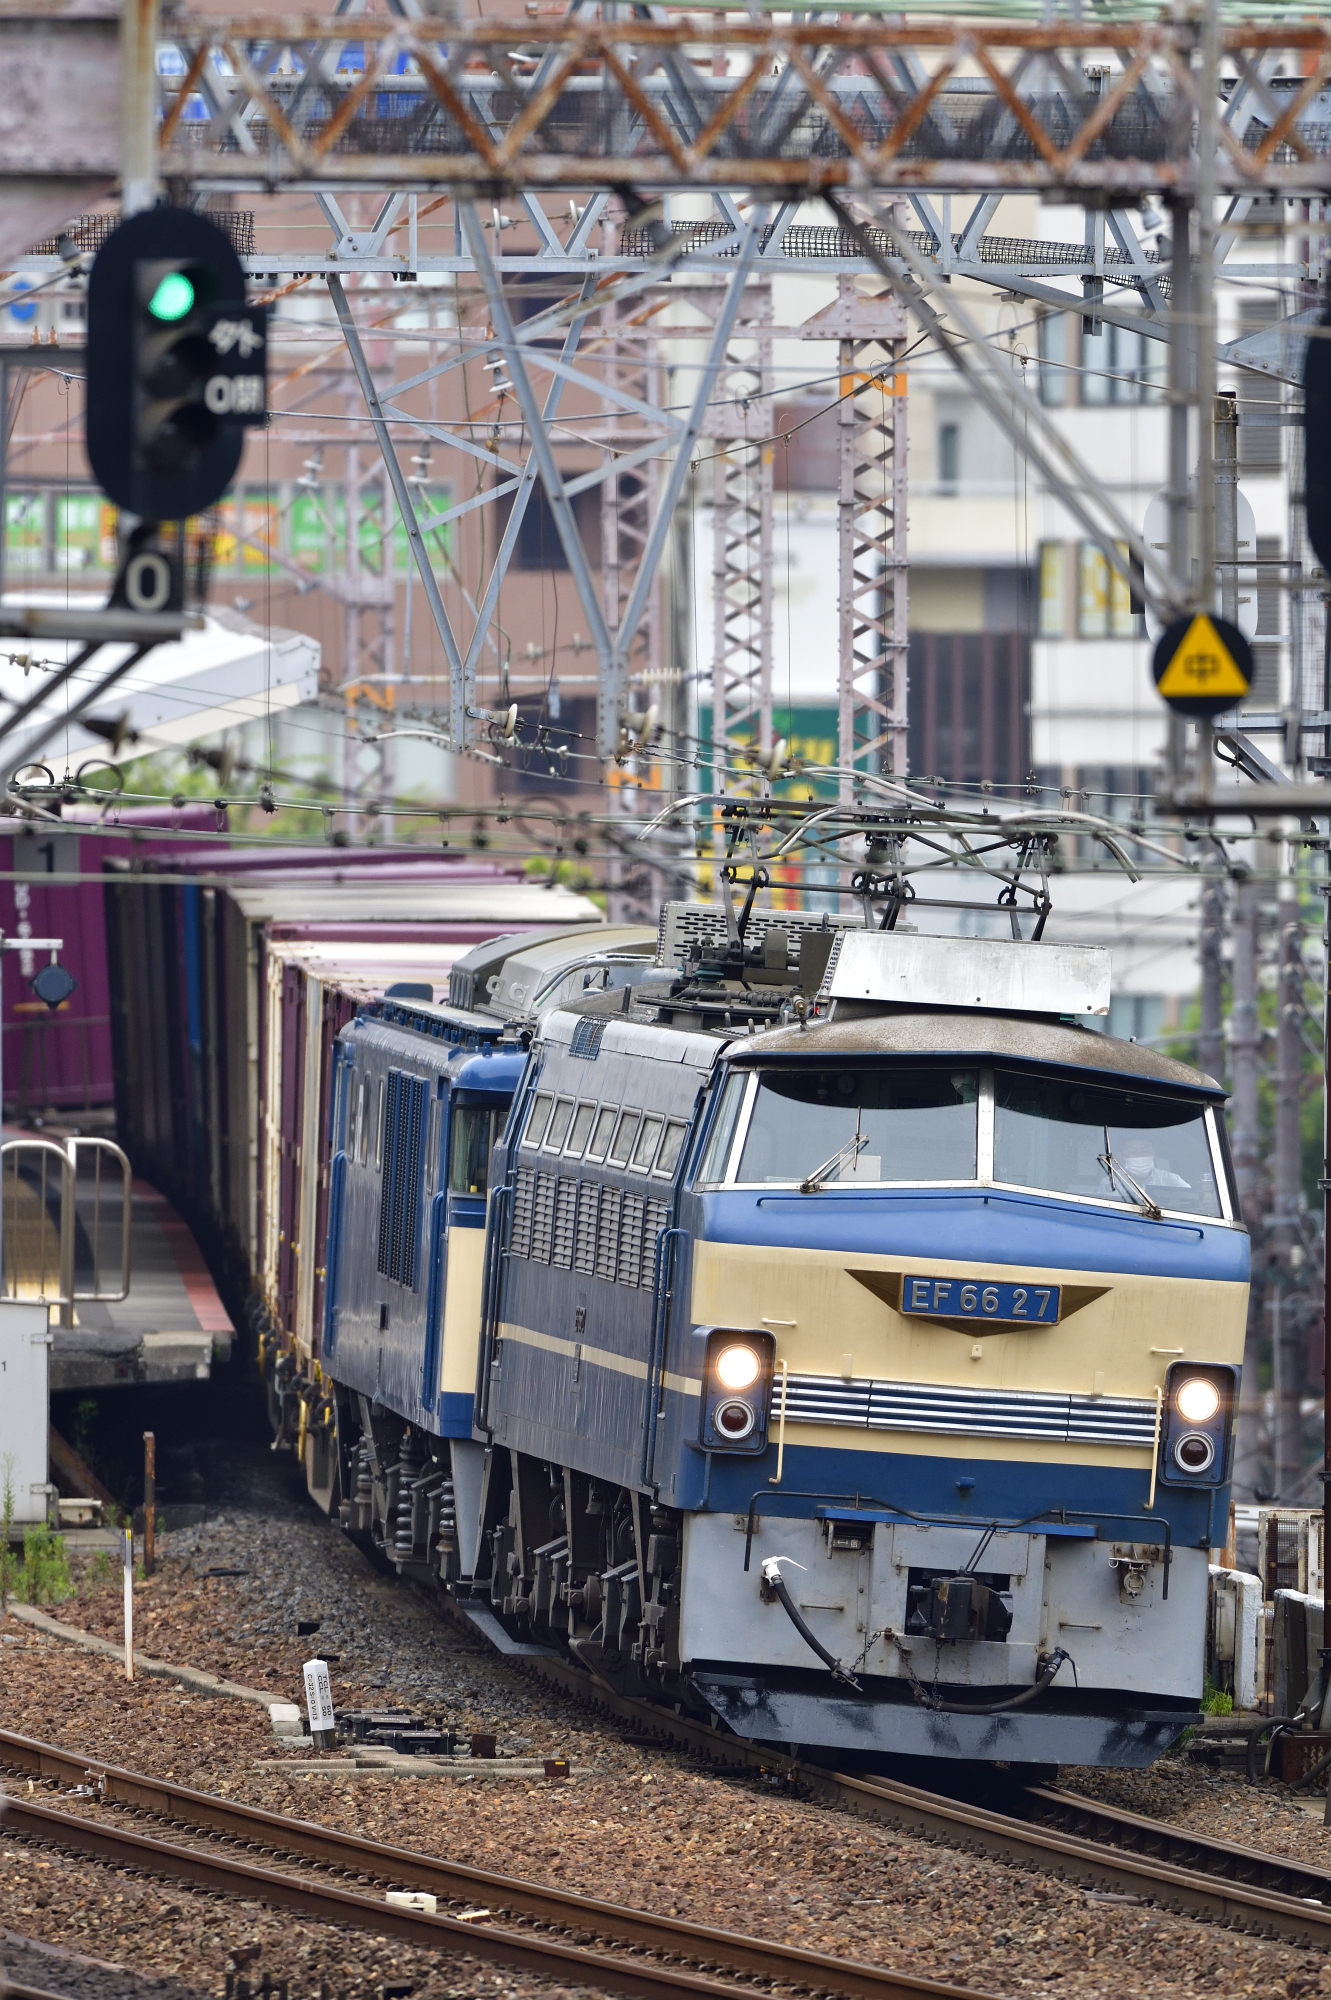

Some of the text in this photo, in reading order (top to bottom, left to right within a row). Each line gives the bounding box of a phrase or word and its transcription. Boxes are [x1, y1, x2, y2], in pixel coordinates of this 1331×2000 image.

[208, 318, 265, 358] 外
[126, 552, 171, 610] 0
[1012, 1288, 1051, 1318] 27
